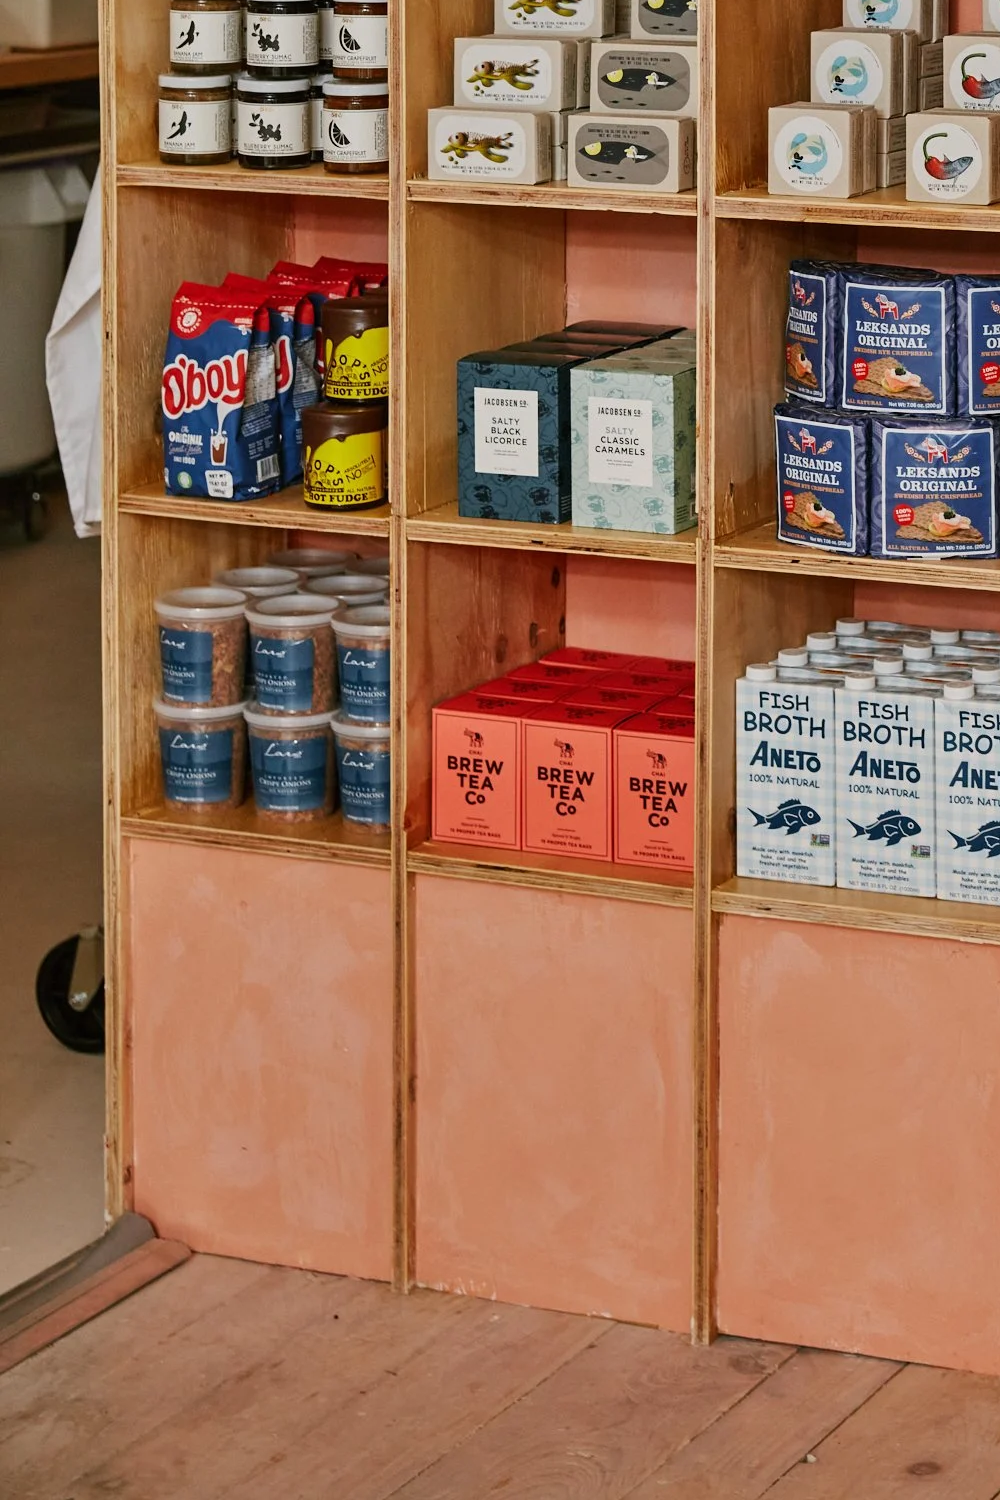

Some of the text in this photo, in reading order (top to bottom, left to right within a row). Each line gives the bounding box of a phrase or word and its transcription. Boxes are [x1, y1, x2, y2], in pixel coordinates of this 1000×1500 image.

[856, 321, 931, 335] LEKSANDS
[858, 335, 927, 348] ORIGINAL
[484, 398, 518, 407] JACOBSEN
[598, 407, 632, 416] JACOBSEN
[492, 417, 520, 425] SALTY
[491, 427, 521, 435] BLACK
[606, 427, 634, 435] SALTY
[485, 437, 527, 446] LICORICE
[601, 436, 639, 445] CLASSIC
[595, 446, 645, 456] CARAMELS
[896, 466, 980, 477] LEKSANDS
[900, 480, 977, 491] ORIGINAL
[310, 493, 368, 502] HOT FUDGE
[759, 692, 809, 712] FISH
[858, 701, 909, 721] FISH
[744, 712, 826, 738] BROTH
[844, 721, 925, 748] BROTH
[447, 756, 503, 775] BREW
[537, 766, 594, 786] BREW
[749, 774, 820, 788] 100% NATURAL
[280, 779, 311, 787] ONIONS
[457, 773, 494, 791] TEA
[547, 784, 584, 802] TEA
